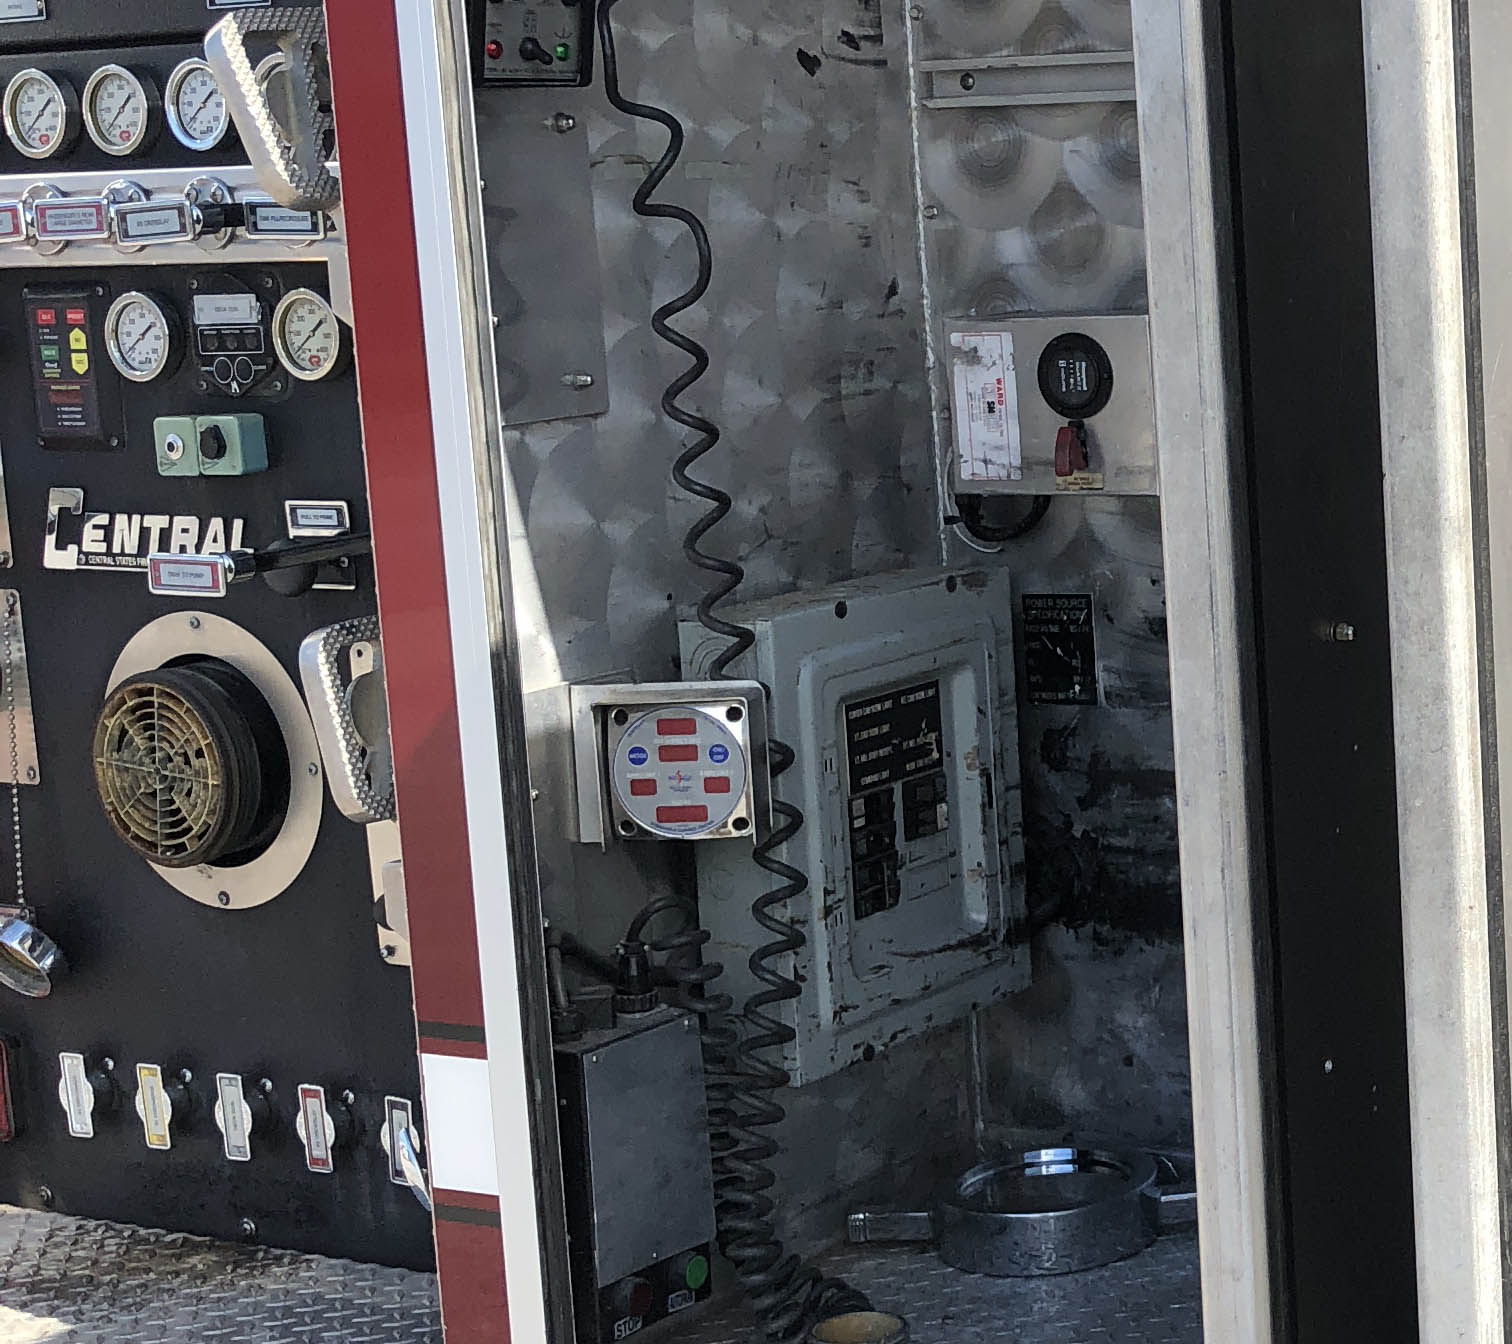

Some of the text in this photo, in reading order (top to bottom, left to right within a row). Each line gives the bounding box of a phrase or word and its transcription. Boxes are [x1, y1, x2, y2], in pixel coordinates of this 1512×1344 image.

[995, 377, 1005, 407] WARD
[43, 487, 254, 569] CENTRAL
[88, 555, 115, 565] CENTRAL
[115, 556, 137, 566] STATES
[1056, 598, 1088, 609] SOURCE
[616, 1316, 640, 1337] STOP
